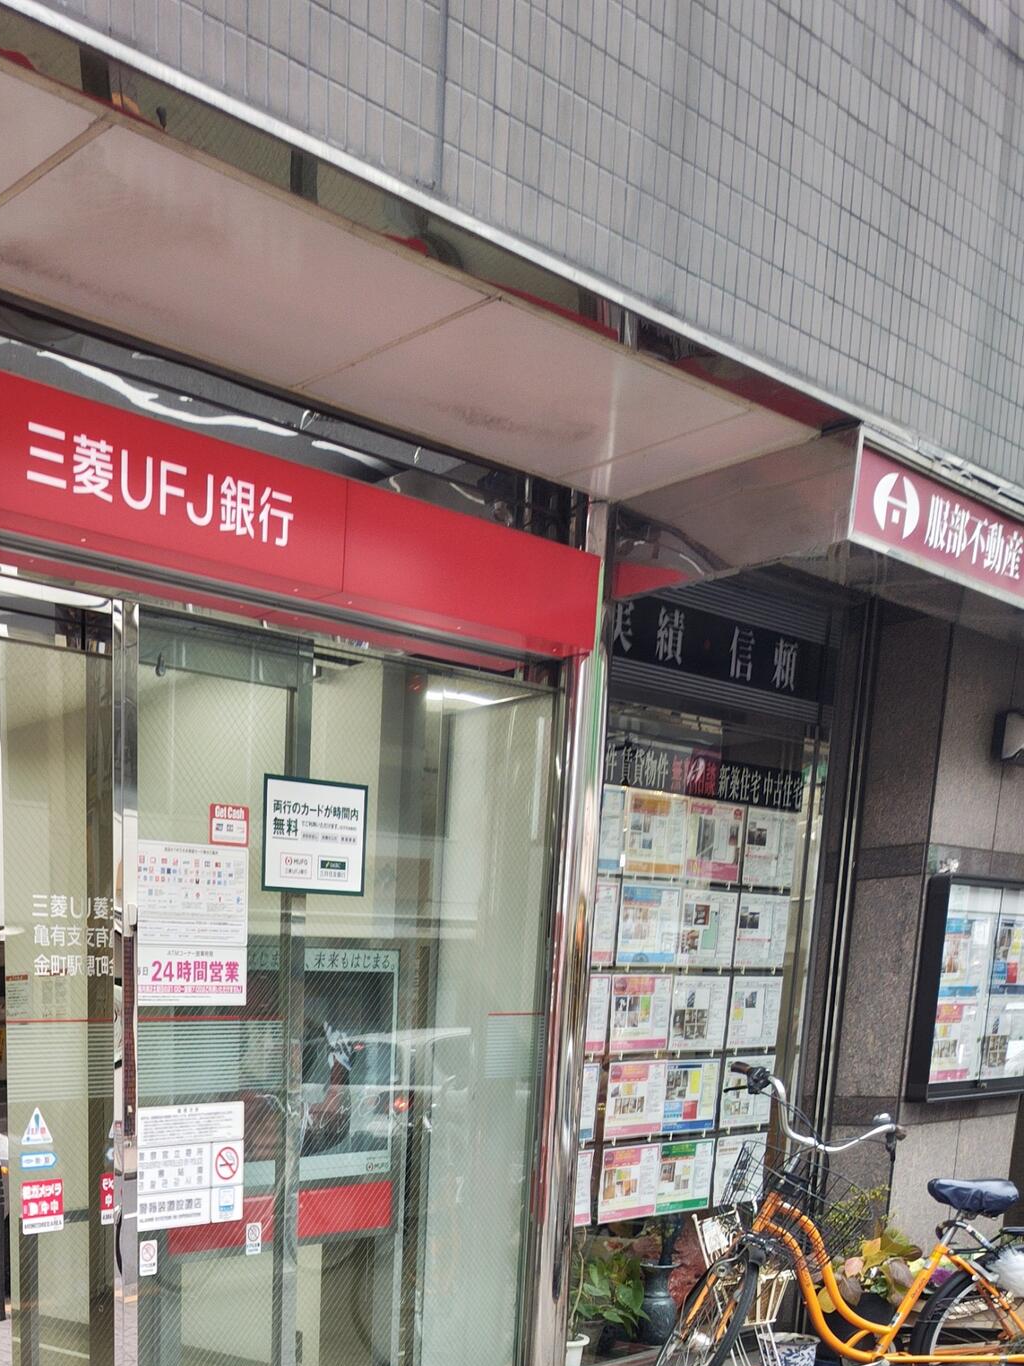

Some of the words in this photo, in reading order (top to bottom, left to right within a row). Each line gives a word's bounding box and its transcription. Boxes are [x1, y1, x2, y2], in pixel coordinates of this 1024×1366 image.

[26, 420, 295, 548] 三菱UFJ銀行
[924, 494, 1024, 580] 服部不動産
[227, 806, 245, 820] Cash
[273, 799, 359, 821] 両行のカードが時間内
[273, 817, 298, 837] 無料
[151, 959, 240, 983] 24時間営業
